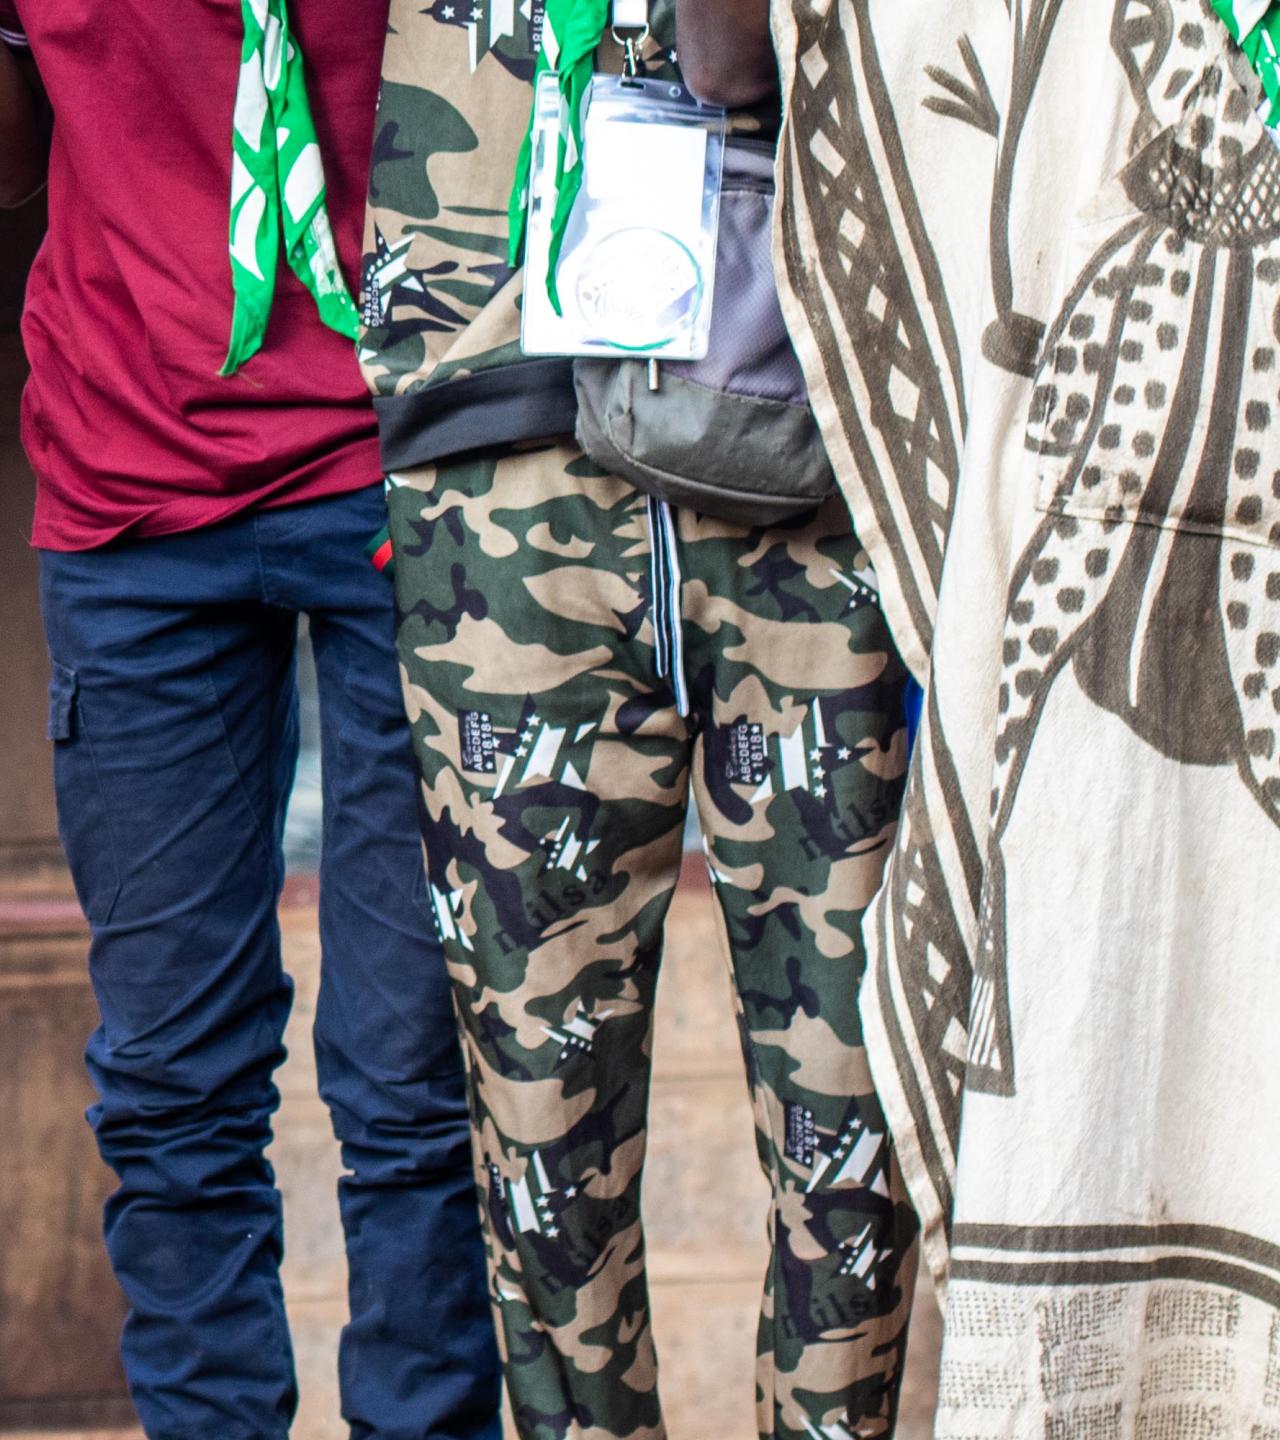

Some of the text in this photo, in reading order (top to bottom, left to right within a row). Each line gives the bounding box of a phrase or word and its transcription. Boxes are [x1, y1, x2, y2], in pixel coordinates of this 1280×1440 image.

[472, 711, 483, 772] ABCDEFG
[483, 722, 493, 757] 1818
[738, 724, 751, 784] ABCDEFG
[751, 734, 763, 768] 1818
